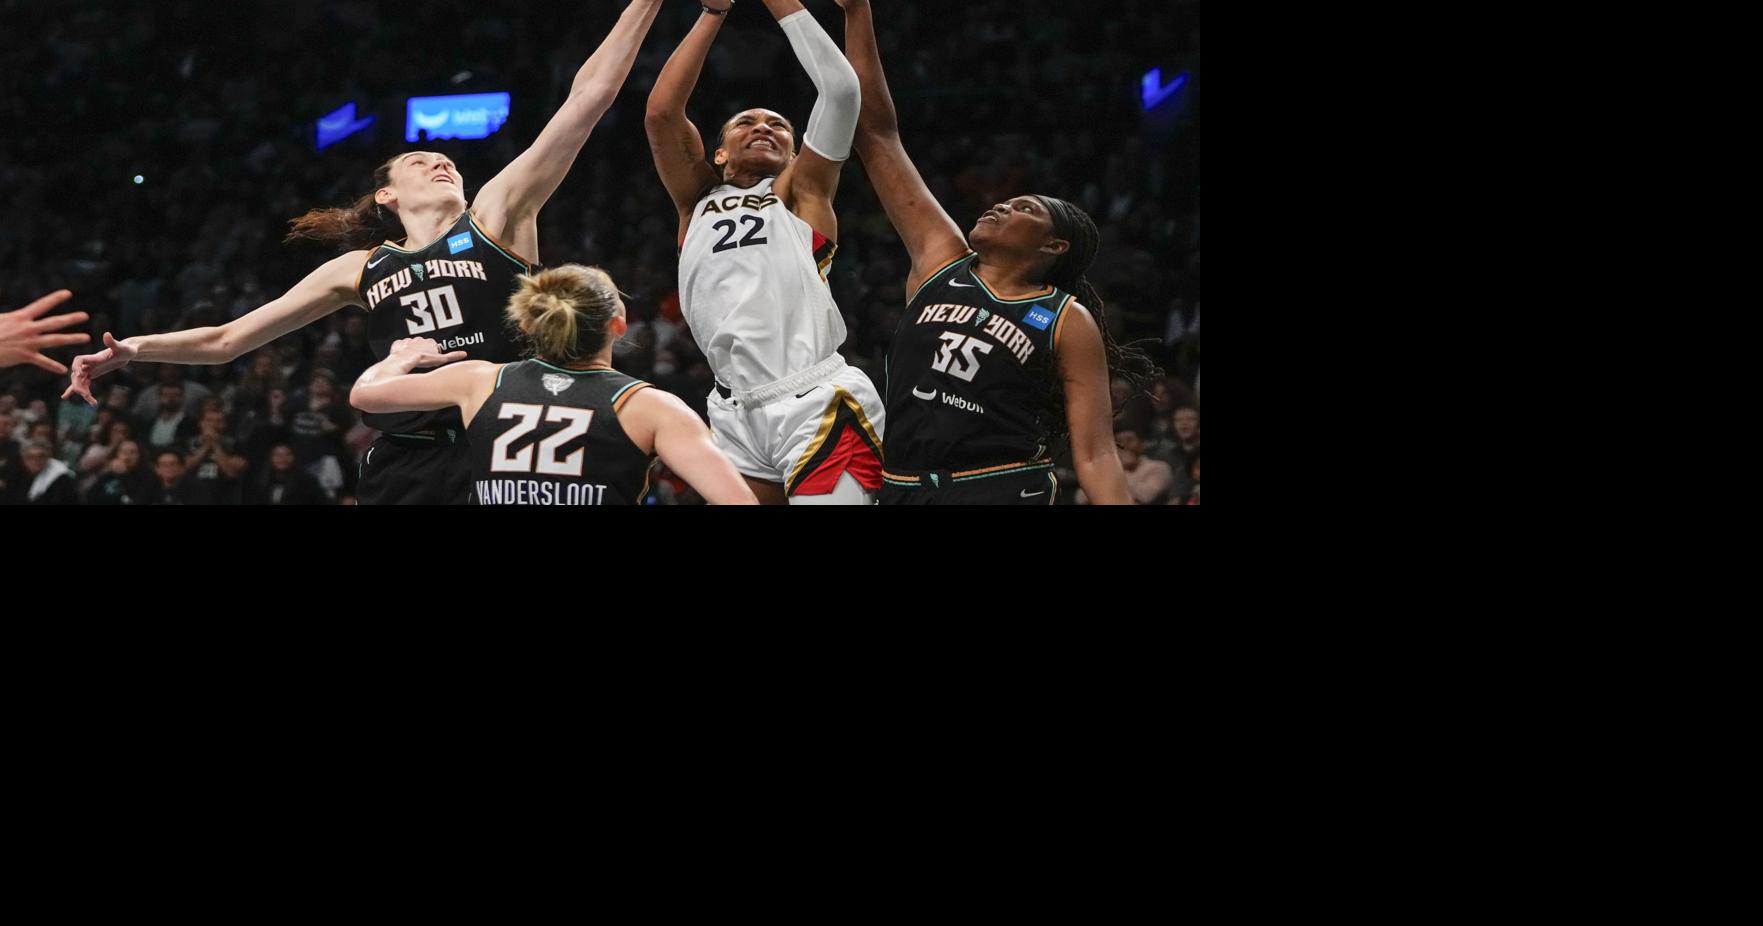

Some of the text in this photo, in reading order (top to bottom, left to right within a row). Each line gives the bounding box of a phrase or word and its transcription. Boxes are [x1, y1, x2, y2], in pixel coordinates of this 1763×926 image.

[700, 192, 778, 217] ACES
[451, 237, 470, 249] HSS
[712, 214, 768, 254] 22
[366, 259, 487, 311] NEW YORK
[399, 284, 464, 335] 30
[1029, 311, 1050, 324] HSS
[915, 303, 1036, 366] NEW YORK
[931, 330, 994, 383] 35
[490, 402, 595, 477] 22
[476, 479, 607, 505] VANDERSLOOT
